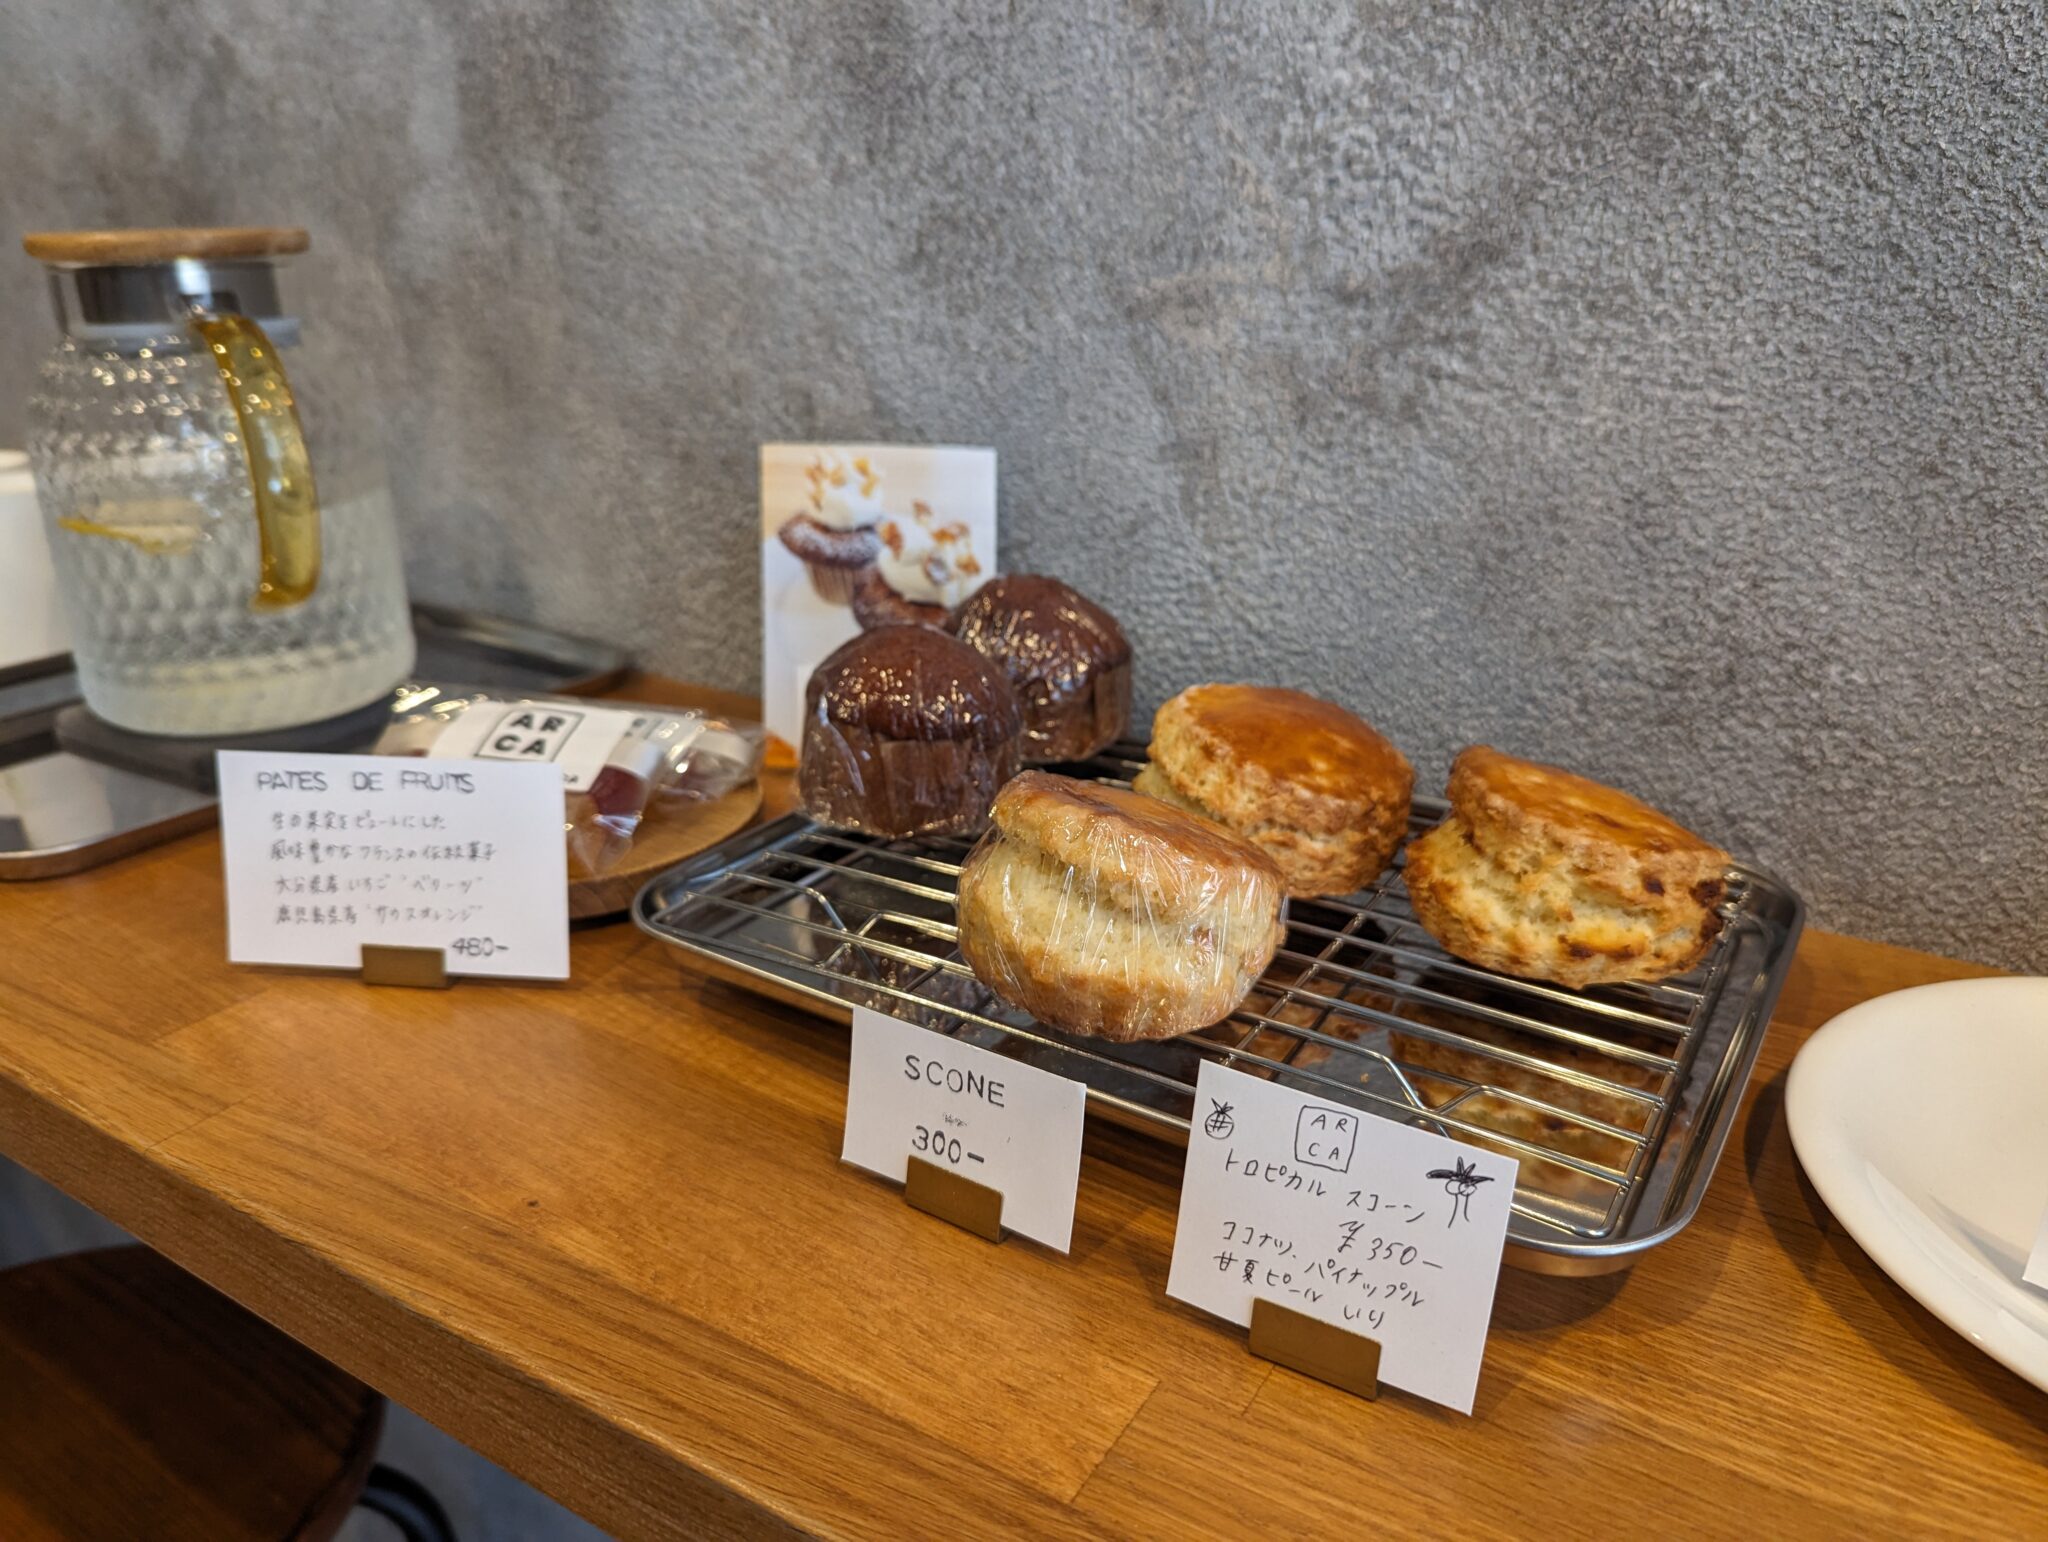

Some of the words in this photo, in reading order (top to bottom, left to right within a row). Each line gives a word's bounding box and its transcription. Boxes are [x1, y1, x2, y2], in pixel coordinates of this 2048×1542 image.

[510, 713, 565, 732] AR
[494, 734, 548, 755] CA
[257, 770, 328, 791] PATES
[352, 771, 384, 791] DE
[400, 770, 475, 793] FRUITS
[904, 1054, 1005, 1108] SCONE
[1225, 1148, 1327, 1197] トロピカル
[1346, 1190, 1425, 1223] スコーン
[1343, 1305, 1386, 1329] いり
